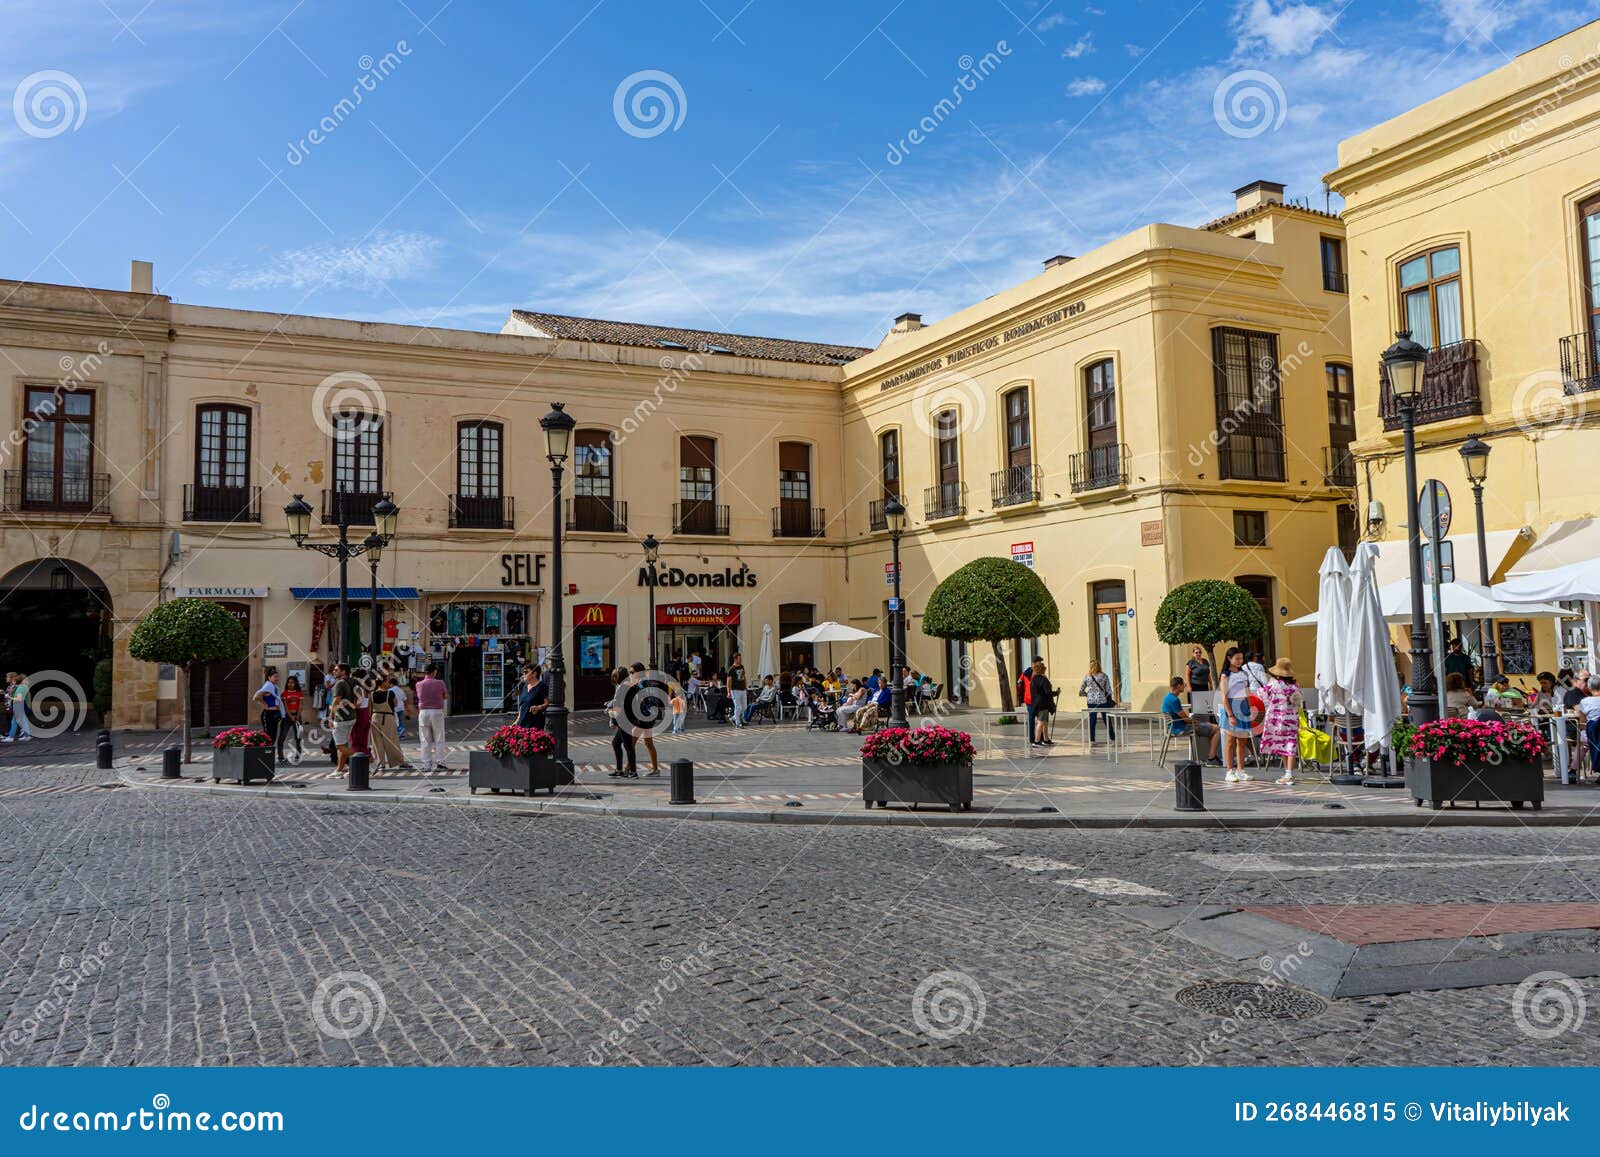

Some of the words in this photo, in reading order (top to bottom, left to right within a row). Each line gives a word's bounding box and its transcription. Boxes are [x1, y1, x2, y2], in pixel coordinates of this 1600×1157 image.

[880, 359, 943, 392] APARTAMENTOS
[1003, 301, 1086, 343] RONDACENTRO
[501, 554, 546, 586] SELF
[638, 567, 758, 588] McDonald's
[188, 587, 256, 596] FARMACIA
[666, 606, 730, 616] McDonald's
[673, 616, 724, 624] RESTAURANTE
